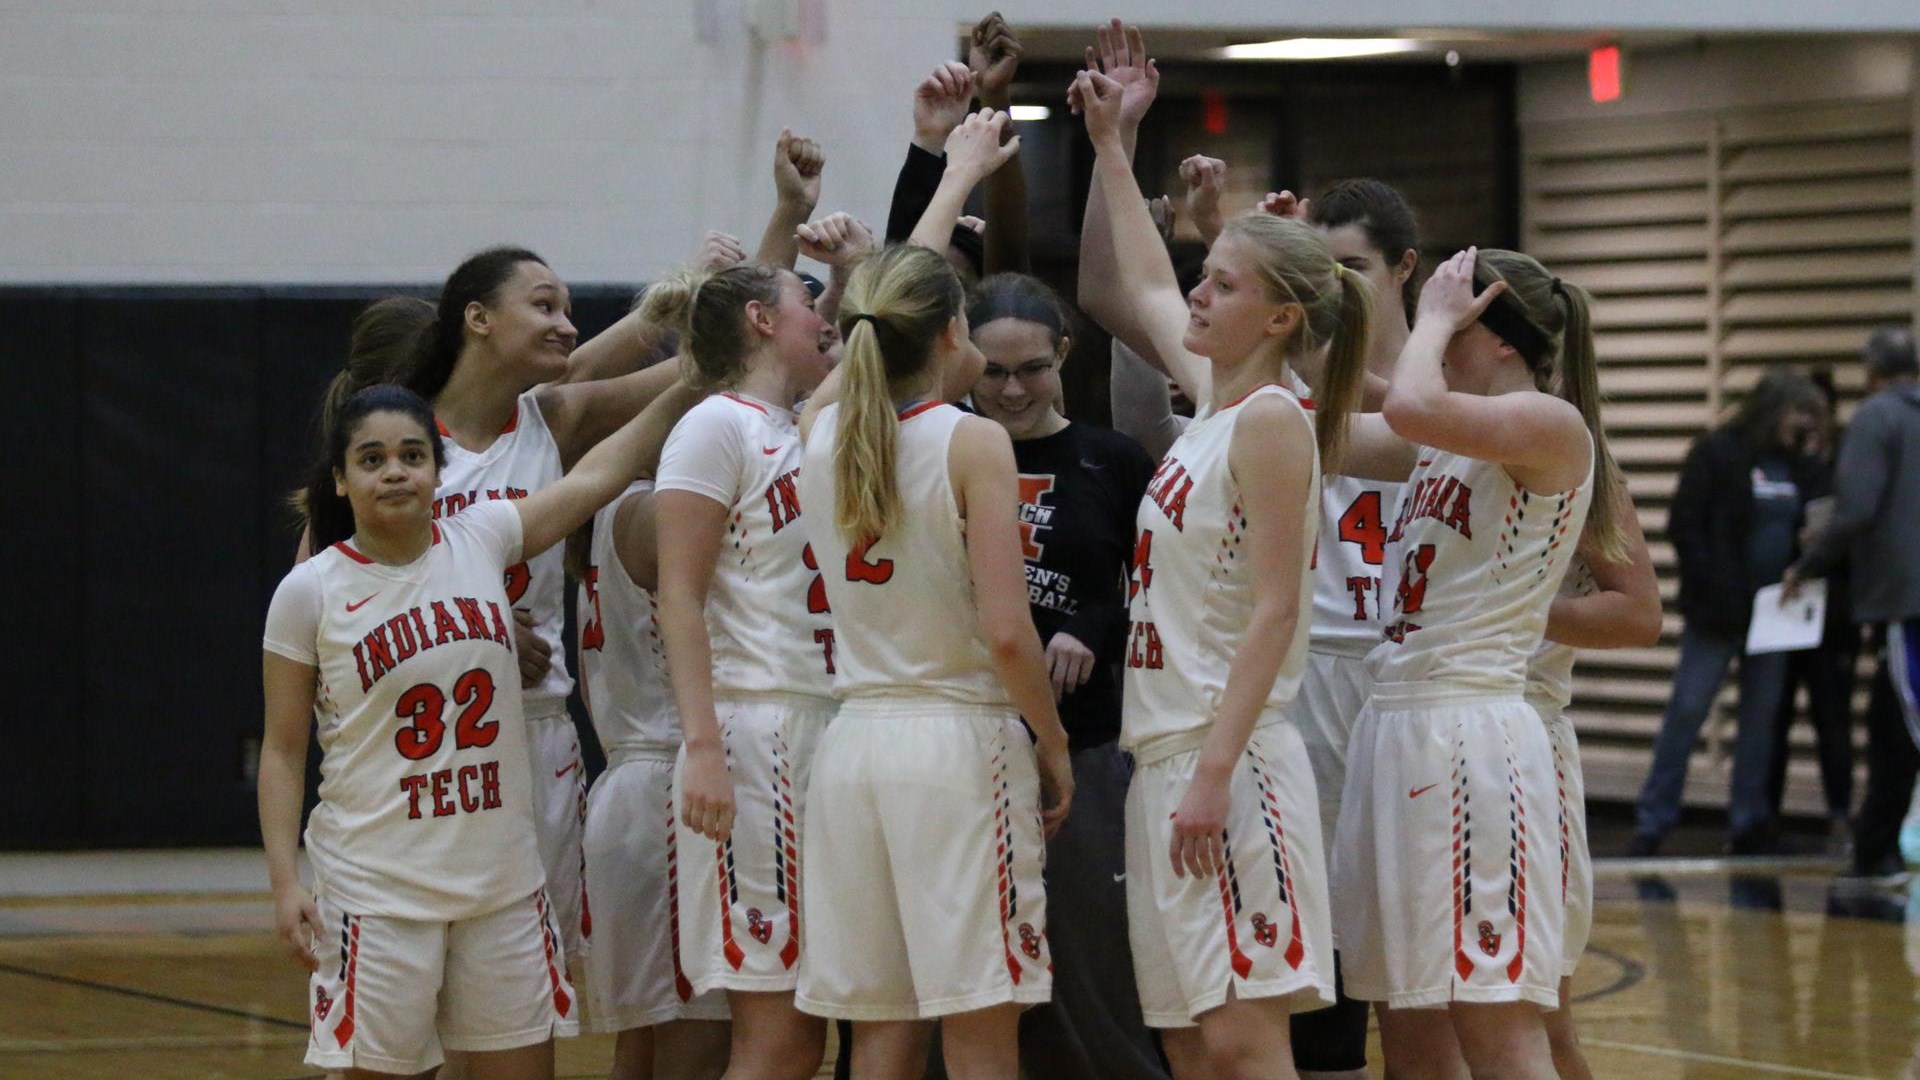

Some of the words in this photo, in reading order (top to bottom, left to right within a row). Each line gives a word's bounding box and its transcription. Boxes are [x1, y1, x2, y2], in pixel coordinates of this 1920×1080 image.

[1018, 502, 1053, 525] CH
[1338, 490, 1388, 565] 4
[1029, 585, 1079, 616] BALL
[1346, 576, 1382, 620] T
[352, 596, 513, 694] INDIANA
[394, 667, 500, 761] 32
[400, 761, 502, 819] TECH
